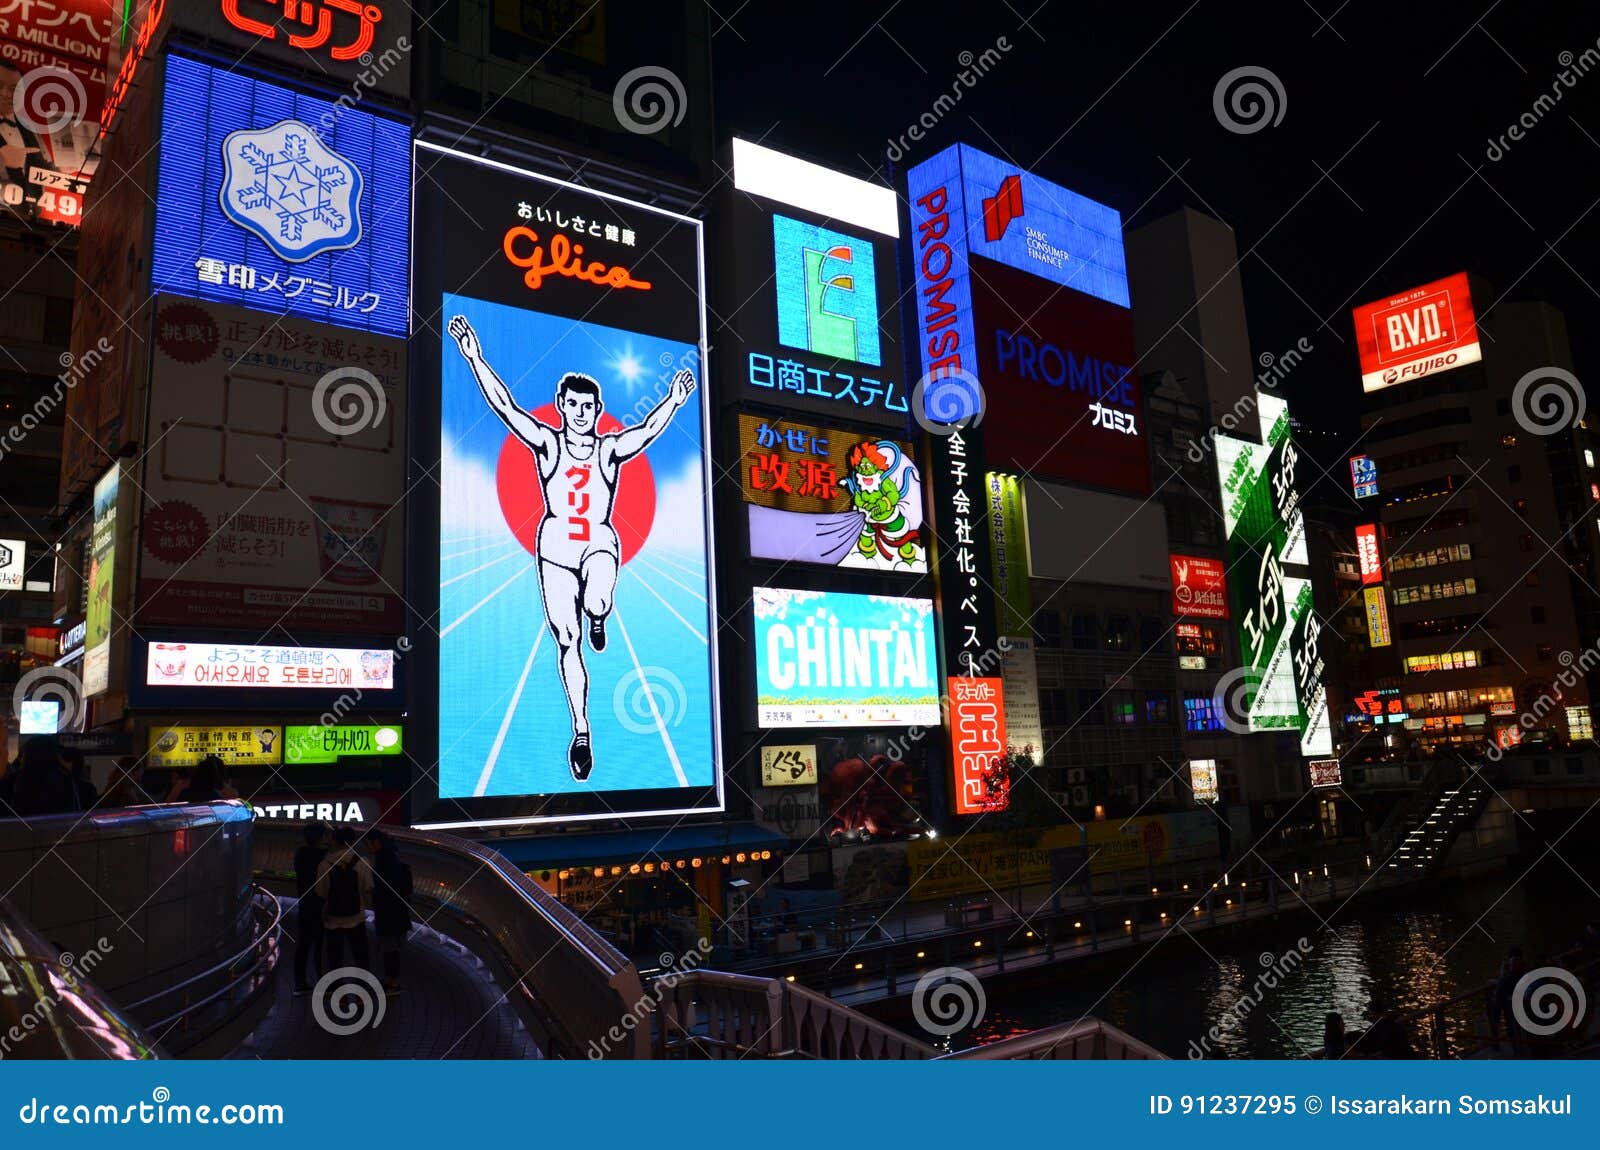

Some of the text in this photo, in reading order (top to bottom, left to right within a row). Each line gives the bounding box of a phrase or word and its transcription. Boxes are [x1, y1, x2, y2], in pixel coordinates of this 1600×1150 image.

[16, 24, 102, 61] MILLION
[517, 201, 636, 248] おいしさと健康
[1025, 226, 1048, 245] SMBC
[503, 226, 652, 290] Glico
[1026, 237, 1070, 262] CONSUMER
[1027, 249, 1063, 270] FINANCE
[194, 256, 381, 314] 雪印メグミルク
[916, 186, 962, 384] PROMISE
[1386, 303, 1448, 353] B.V.D.
[749, 353, 909, 413] 日商エステム
[994, 327, 1137, 408] PROMISE
[1401, 353, 1458, 378] FUJIBO
[1088, 402, 1139, 436] プロミス
[757, 423, 831, 456] かぜに
[748, 453, 840, 500] 改源
[565, 463, 592, 542] グリコ
[947, 423, 981, 678] 全子会社化。ベスト
[1243, 546, 1286, 668] エイブル
[206, 646, 342, 665] ようこそ道頓堀へ
[766, 608, 929, 690] CHINTAI
[194, 664, 270, 684] 어서오세요
[958, 682, 996, 700] スーパー
[323, 729, 371, 752] ピタットハウス
[772, 751, 807, 779] くくる
[252, 801, 364, 822] OTTERIA
